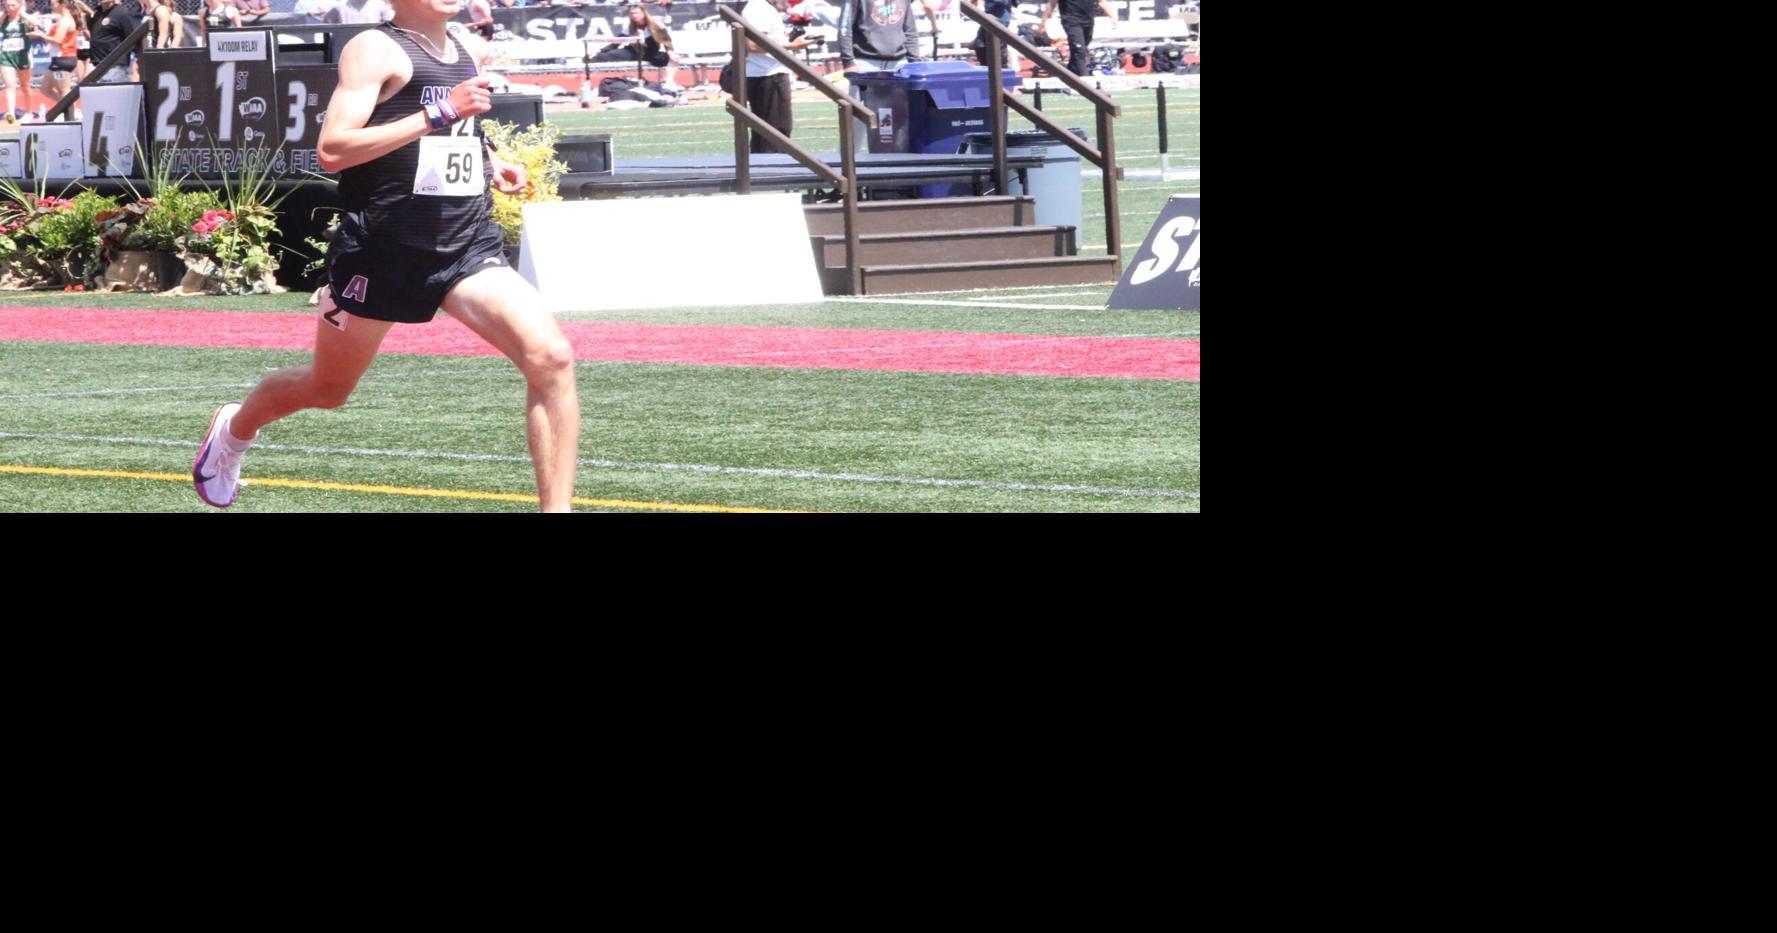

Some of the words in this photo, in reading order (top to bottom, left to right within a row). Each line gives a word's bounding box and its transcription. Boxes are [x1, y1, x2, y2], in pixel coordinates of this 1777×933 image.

[241, 40, 258, 53] RELAY
[159, 148, 211, 173] STATE
[212, 148, 271, 173] TRACK
[290, 149, 337, 174] FIE
[445, 152, 473, 184] 59
